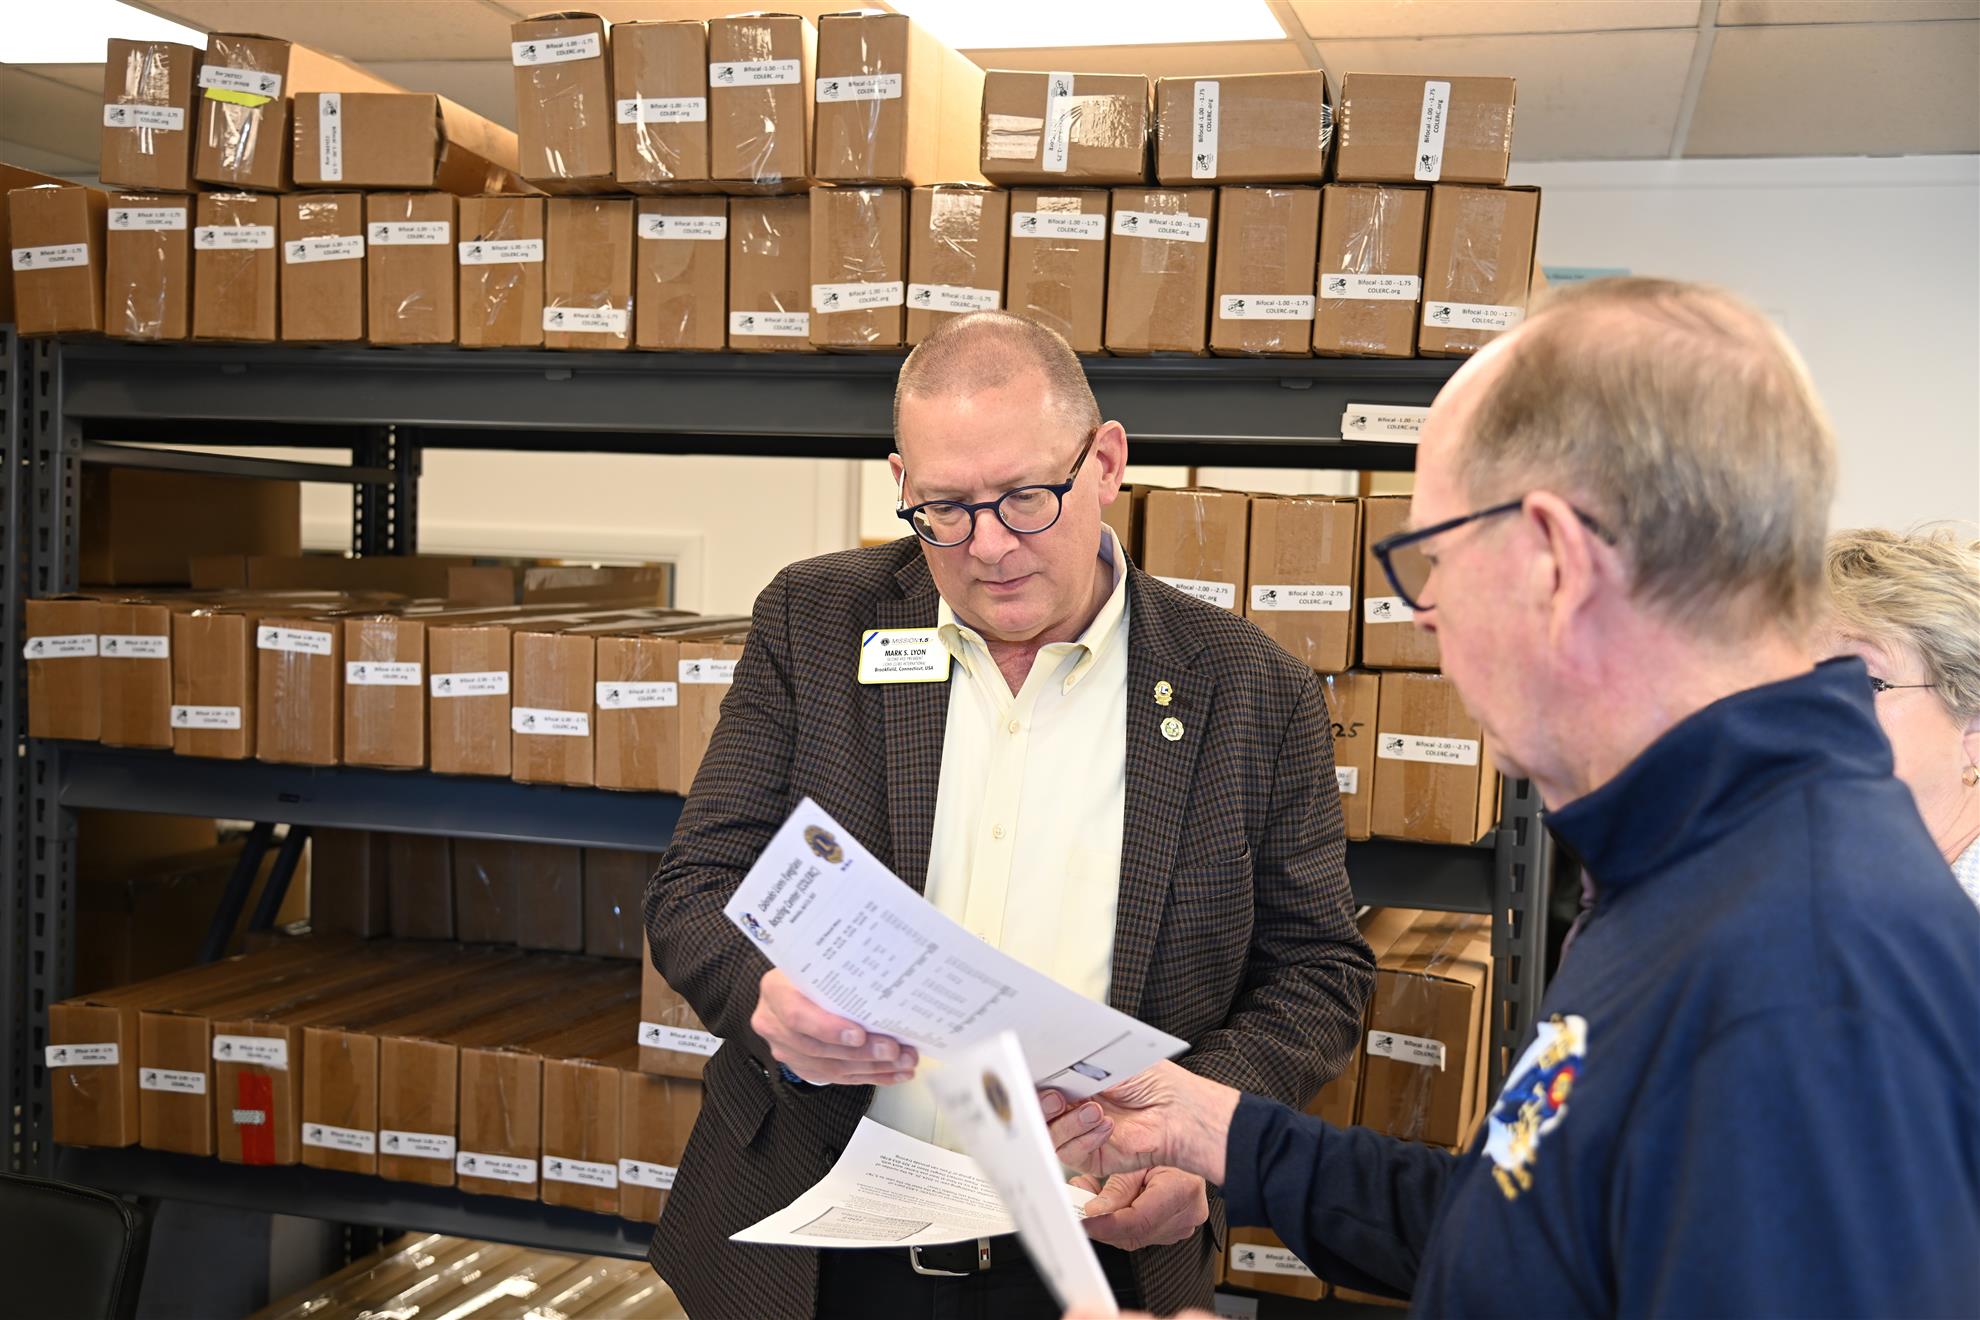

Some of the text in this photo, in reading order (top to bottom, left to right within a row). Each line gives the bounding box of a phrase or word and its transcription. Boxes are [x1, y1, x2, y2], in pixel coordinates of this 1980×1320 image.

[1205, 99, 1214, 133] COLERC.org
[1432, 99, 1444, 133] COLERC.org
[1423, 124, 1431, 143] Bifocal
[1158, 227, 1189, 236] COLERC.org
